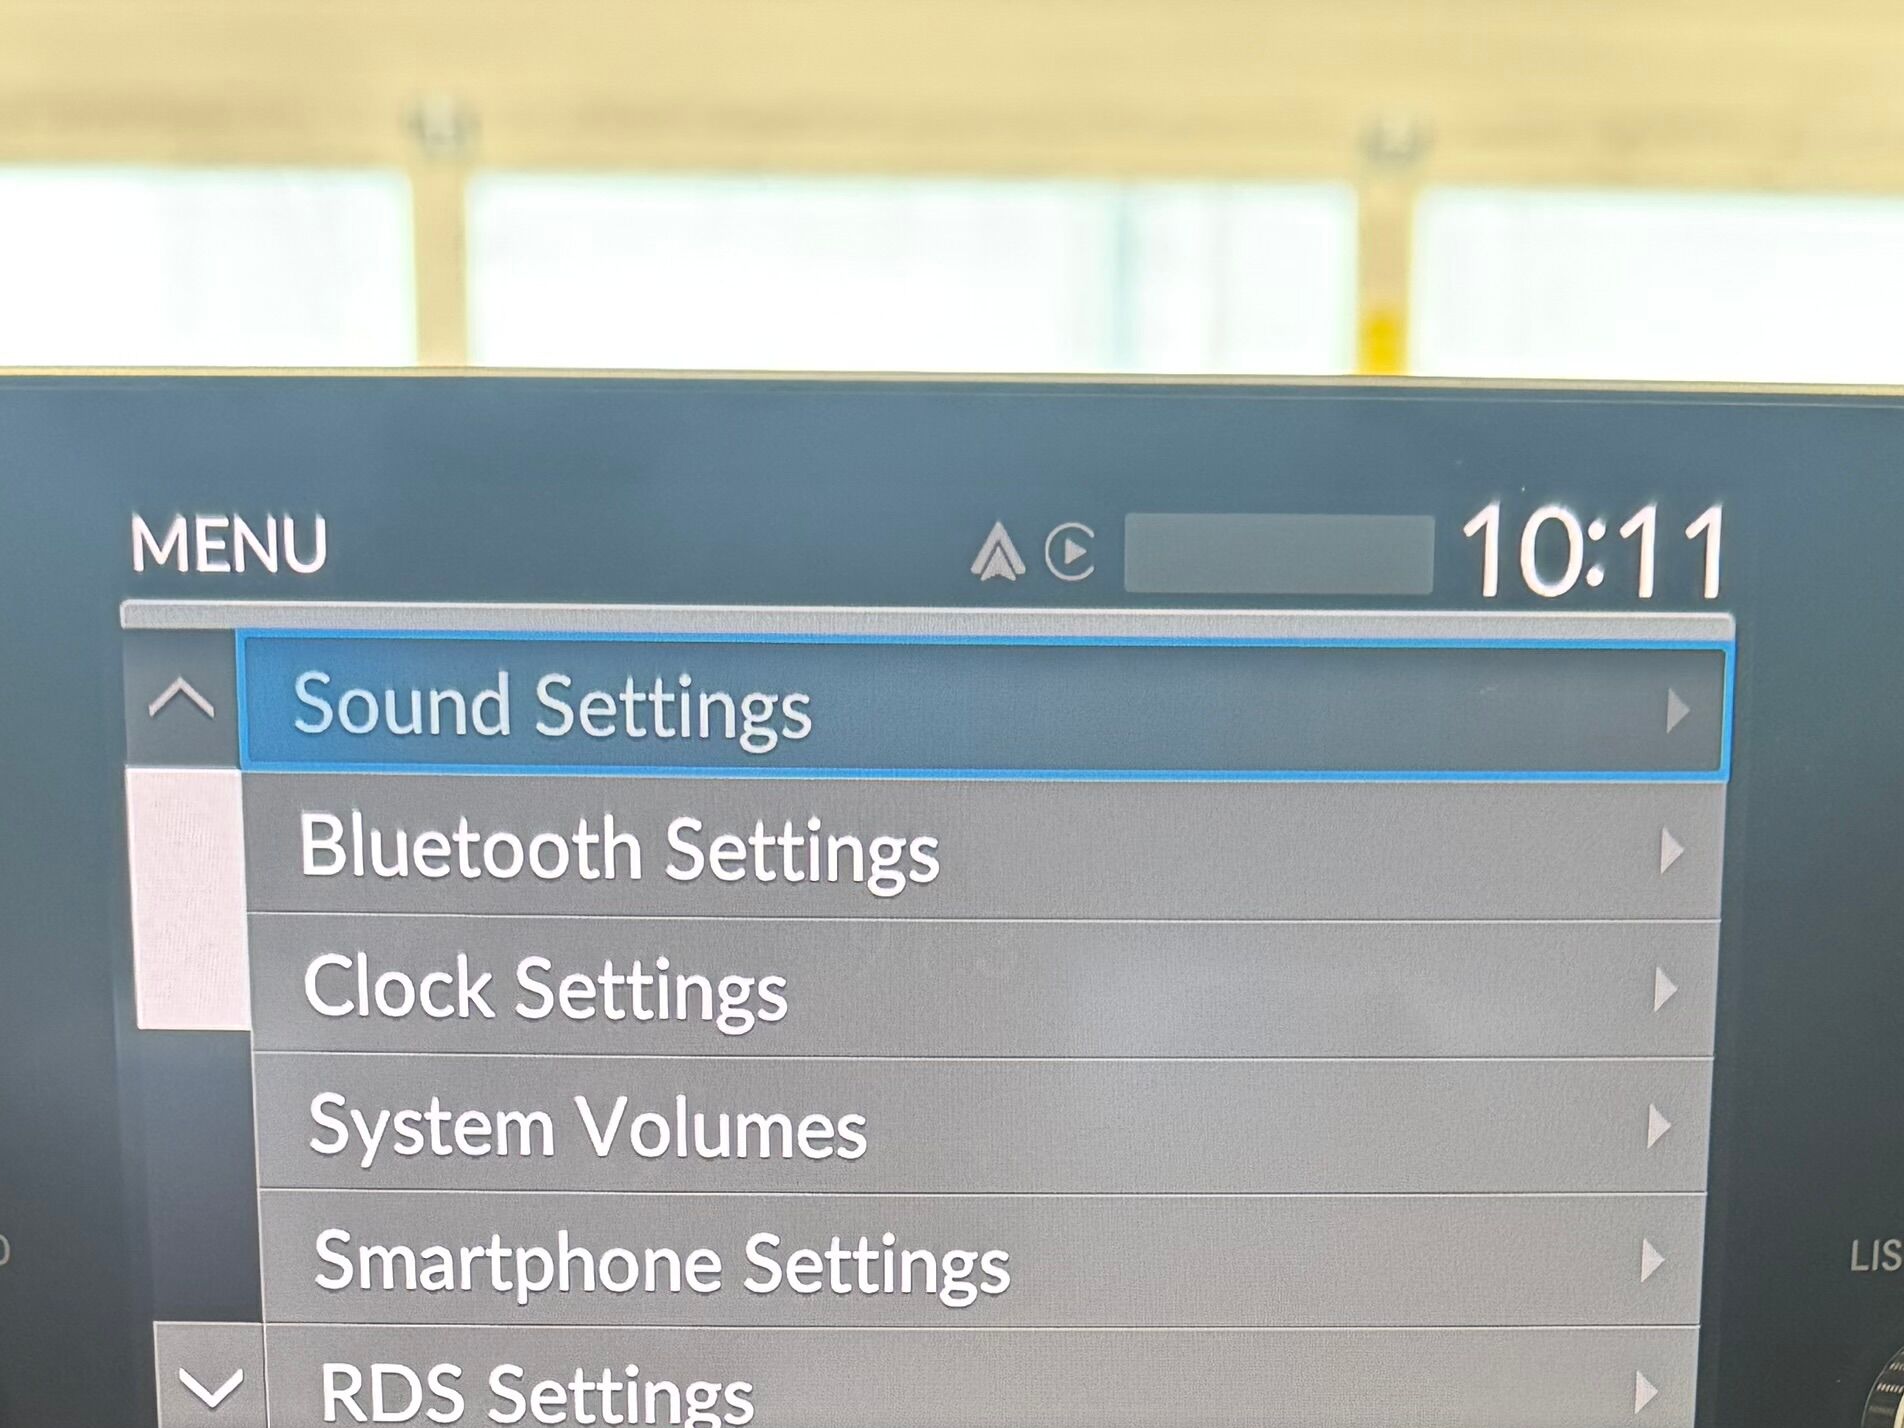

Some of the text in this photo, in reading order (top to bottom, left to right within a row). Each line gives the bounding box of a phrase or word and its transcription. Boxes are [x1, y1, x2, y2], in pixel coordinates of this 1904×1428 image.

[131, 513, 328, 574] MENU
[1463, 500, 1723, 599] 10:11
[295, 670, 813, 754] Sound Settings
[301, 810, 940, 897] Bluetooth Settings
[304, 952, 789, 1034] Clock Settings
[309, 1092, 868, 1168] System Volumes
[315, 1229, 1010, 1307] Smartphone Settings
[322, 1363, 464, 1424] RDS
